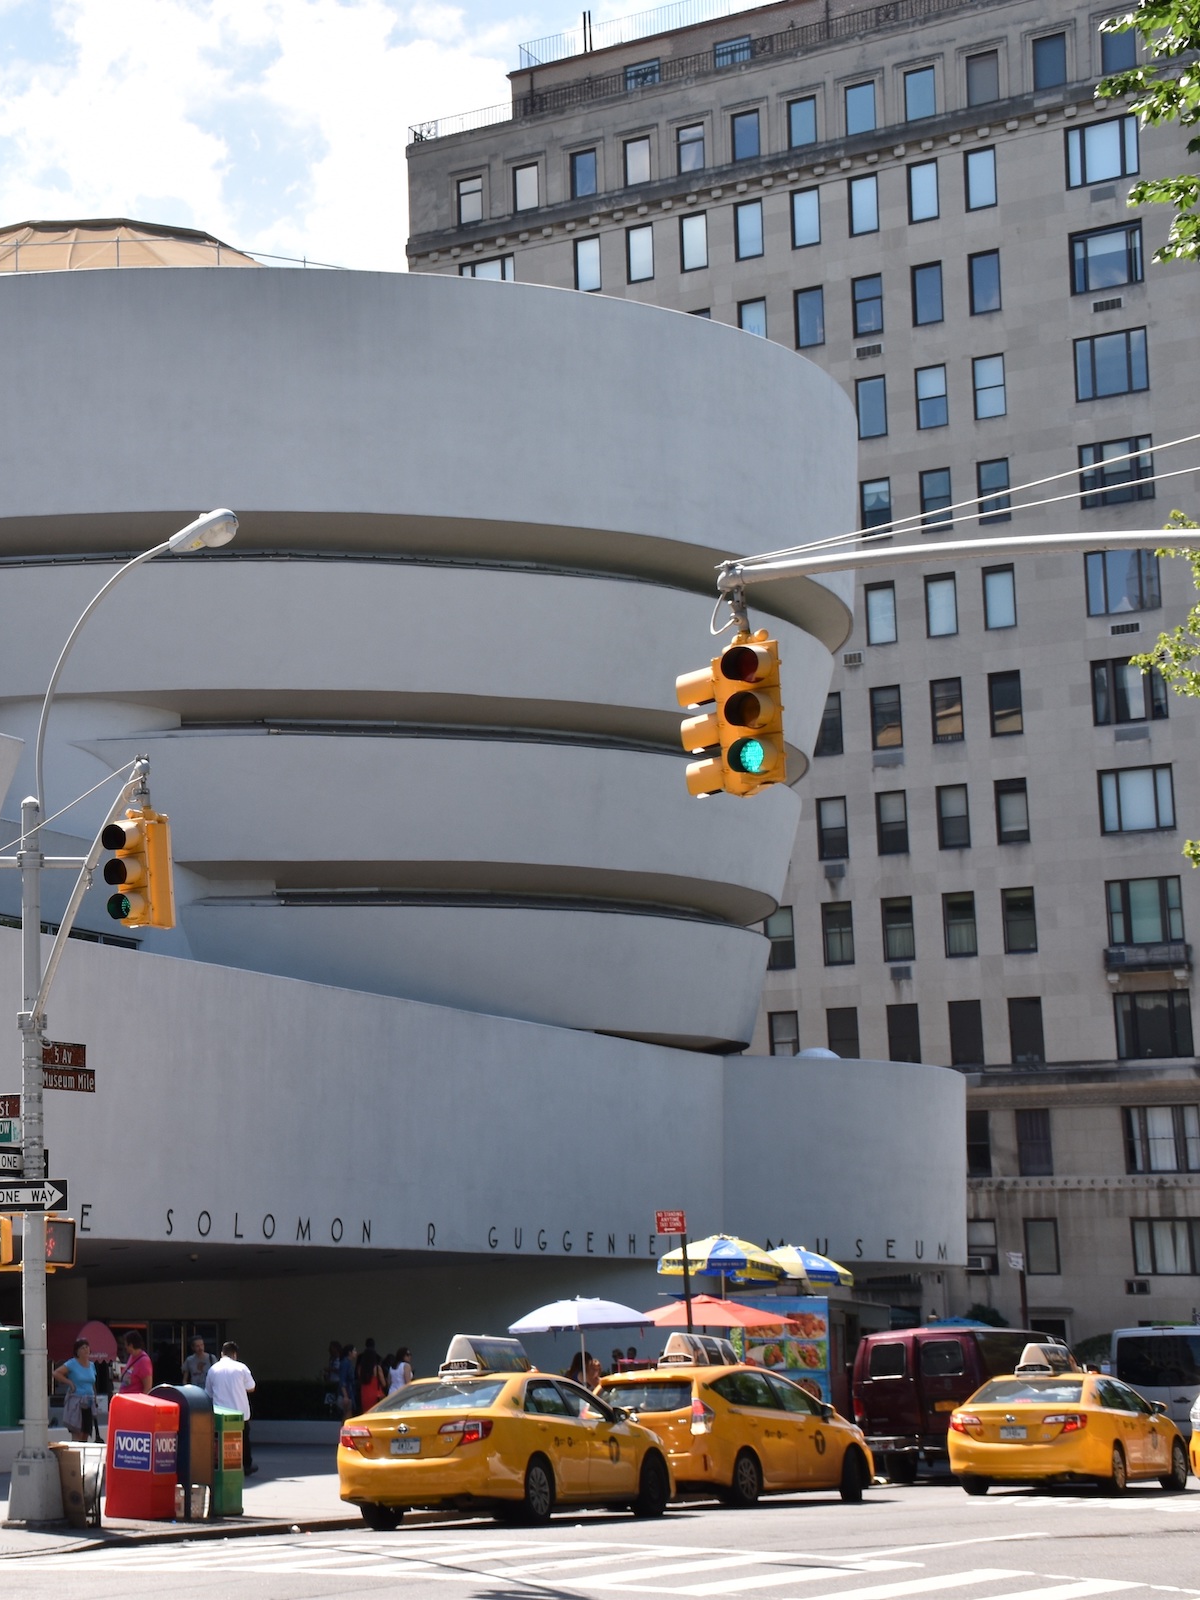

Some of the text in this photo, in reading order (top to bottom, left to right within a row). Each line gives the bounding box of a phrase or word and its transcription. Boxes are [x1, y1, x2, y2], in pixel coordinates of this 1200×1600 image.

[54, 1046, 72, 1064] 5 Av
[42, 1071, 94, 1090] Museum Mile
[1, 1155, 18, 1168] ONE
[31, 1189, 55, 1202] WAY
[166, 1208, 372, 1244] SOLOMON
[427, 1222, 436, 1247] R
[488, 1226, 693, 1255] GUGGENHEI
[118, 1436, 150, 1453] VOICE
[157, 1438, 176, 1453] VOICE
